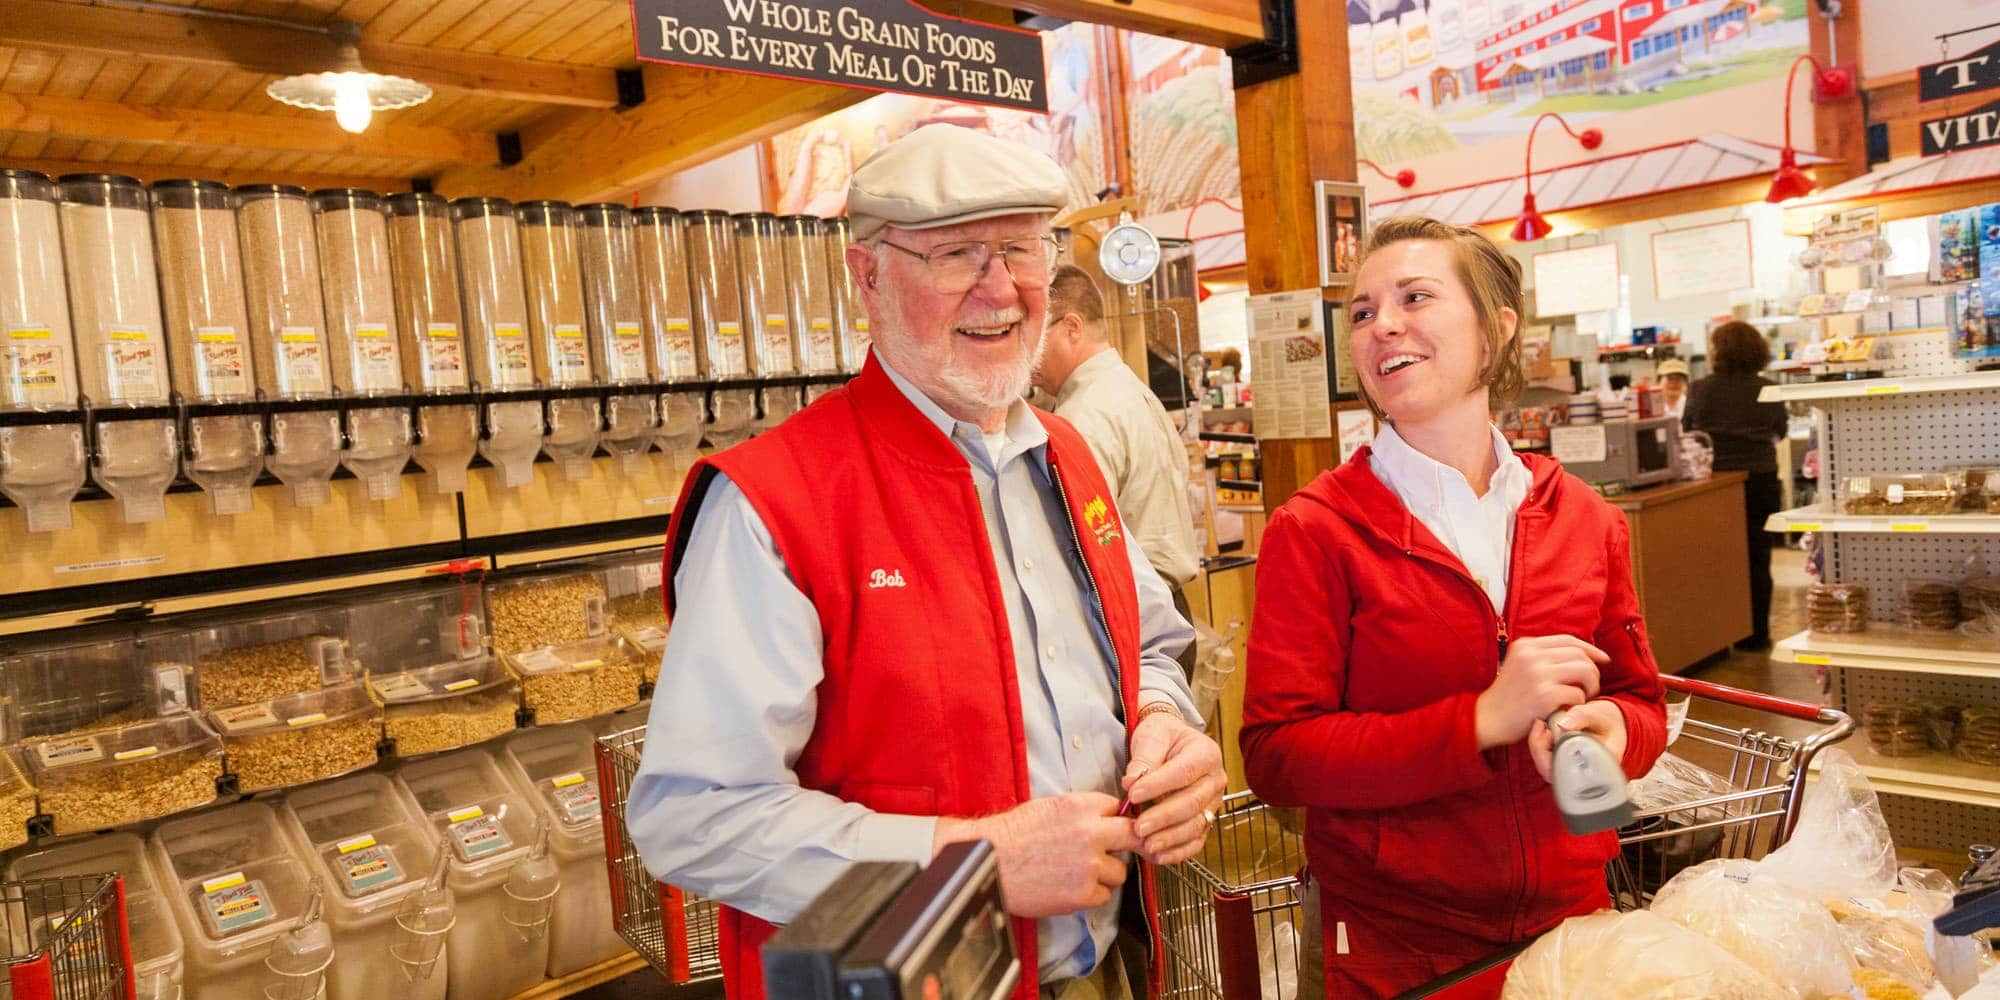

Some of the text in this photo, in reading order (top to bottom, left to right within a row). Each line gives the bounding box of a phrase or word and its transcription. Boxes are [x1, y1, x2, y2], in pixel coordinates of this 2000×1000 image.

[657, 15, 1034, 101] FOR EVERY MEAL OF THE DAY
[723, 0, 996, 64] WHOLE GRAIN FOODS
[868, 568, 907, 588] Bob
